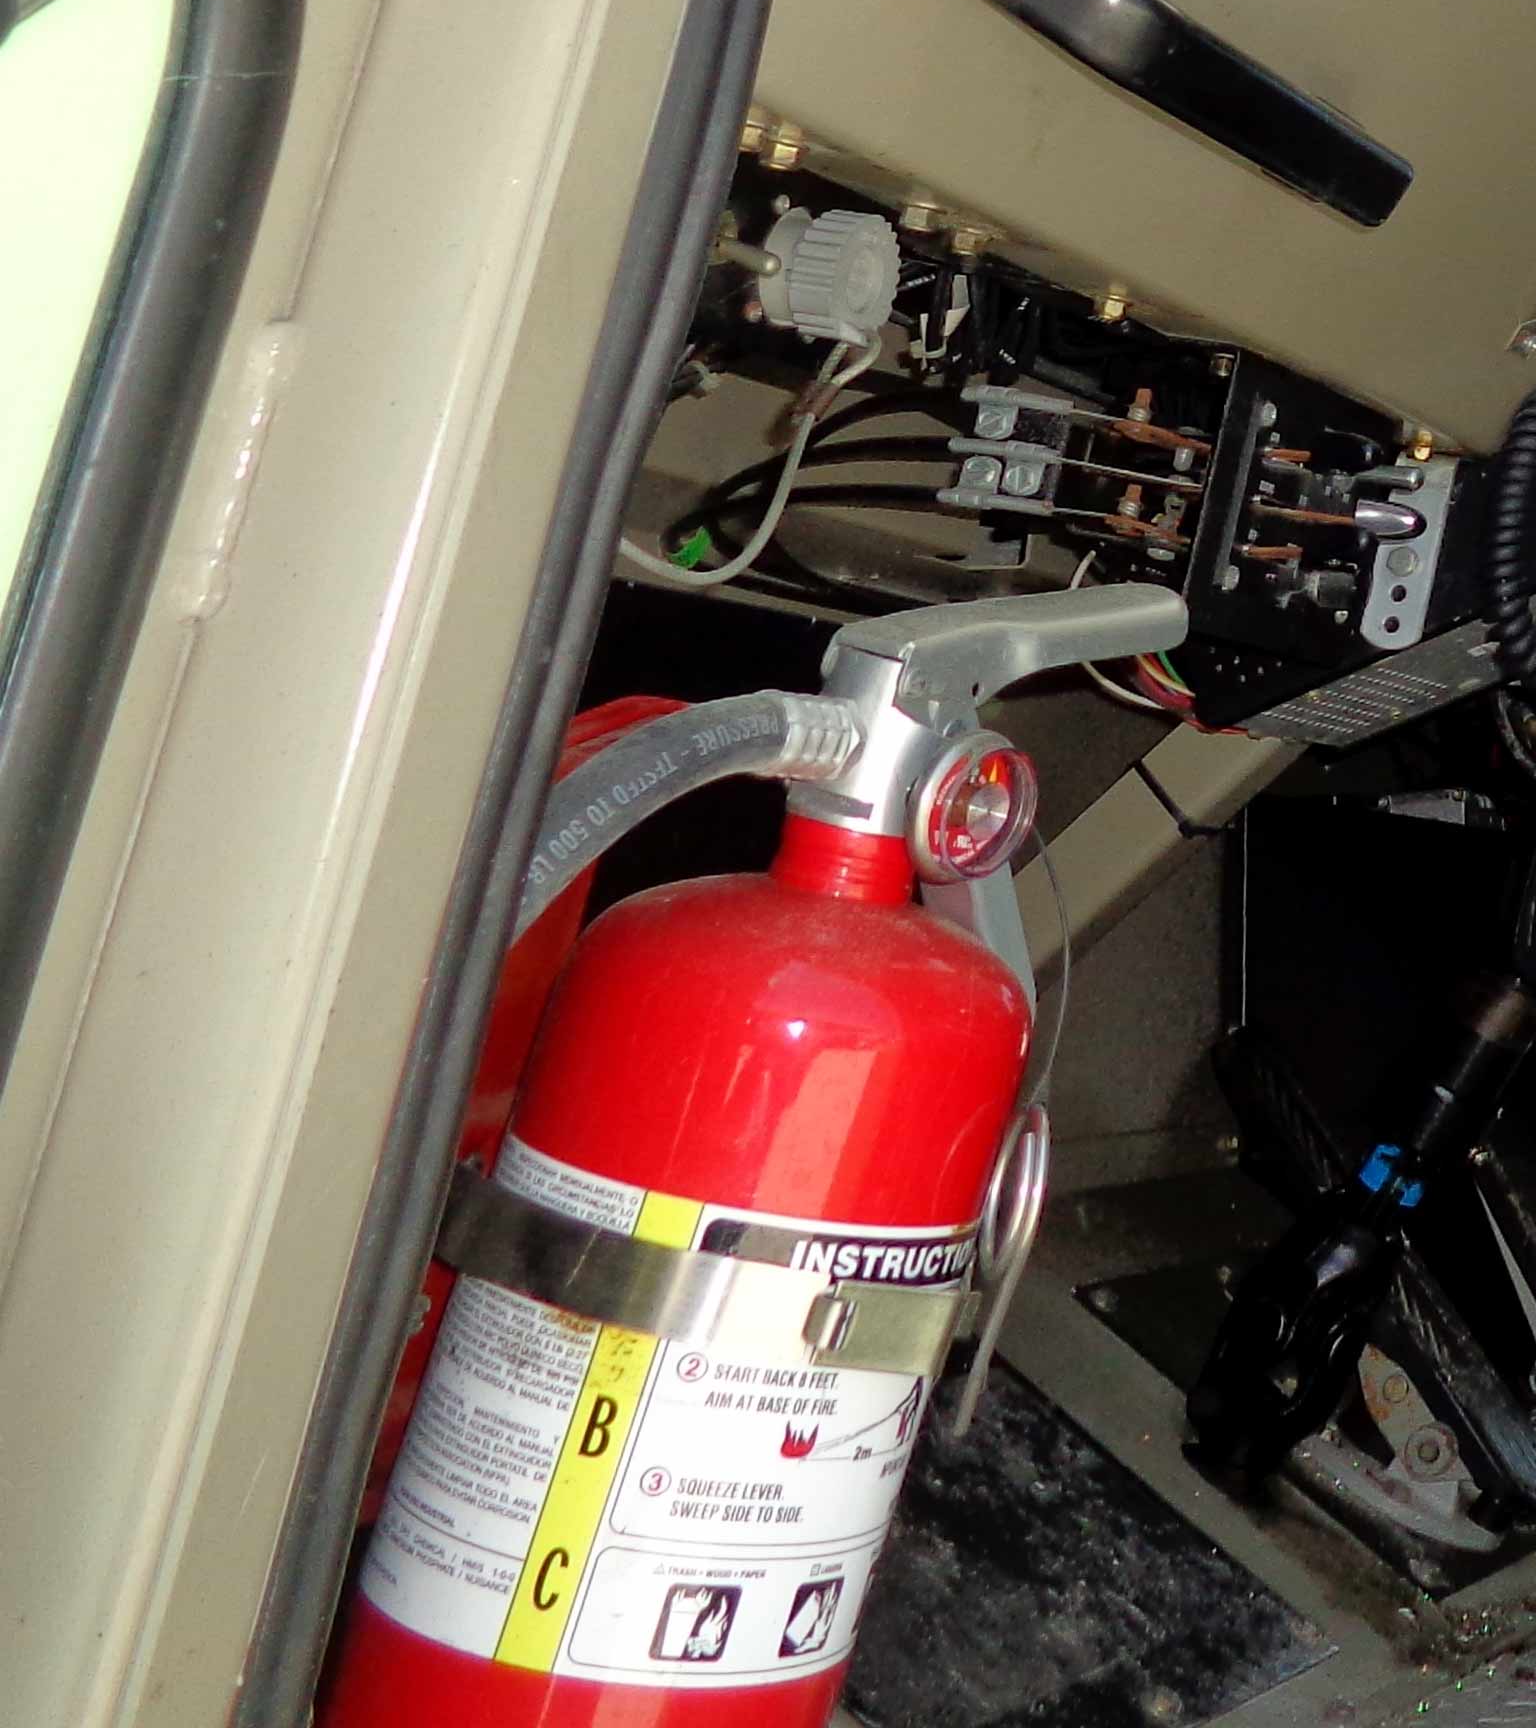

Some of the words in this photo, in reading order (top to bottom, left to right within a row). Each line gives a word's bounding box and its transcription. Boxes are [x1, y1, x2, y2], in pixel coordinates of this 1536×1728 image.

[692, 711, 779, 757] PRESSURE
[611, 751, 678, 805] TESTED
[586, 797, 616, 826] TO
[550, 819, 589, 860] 500
[714, 1363, 760, 1385] START
[762, 1368, 795, 1388] BACK
[704, 1390, 733, 1409] AIM
[735, 1394, 755, 1411] AT
[756, 1396, 790, 1415] BASE
[792, 1398, 809, 1416] OF
[577, 1392, 619, 1459] B
[676, 1477, 740, 1500] SQUEEZE
[670, 1499, 720, 1521] SWEEP
[721, 1504, 751, 1523] SIDE
[755, 1506, 773, 1523] TO
[532, 1546, 571, 1612] C
